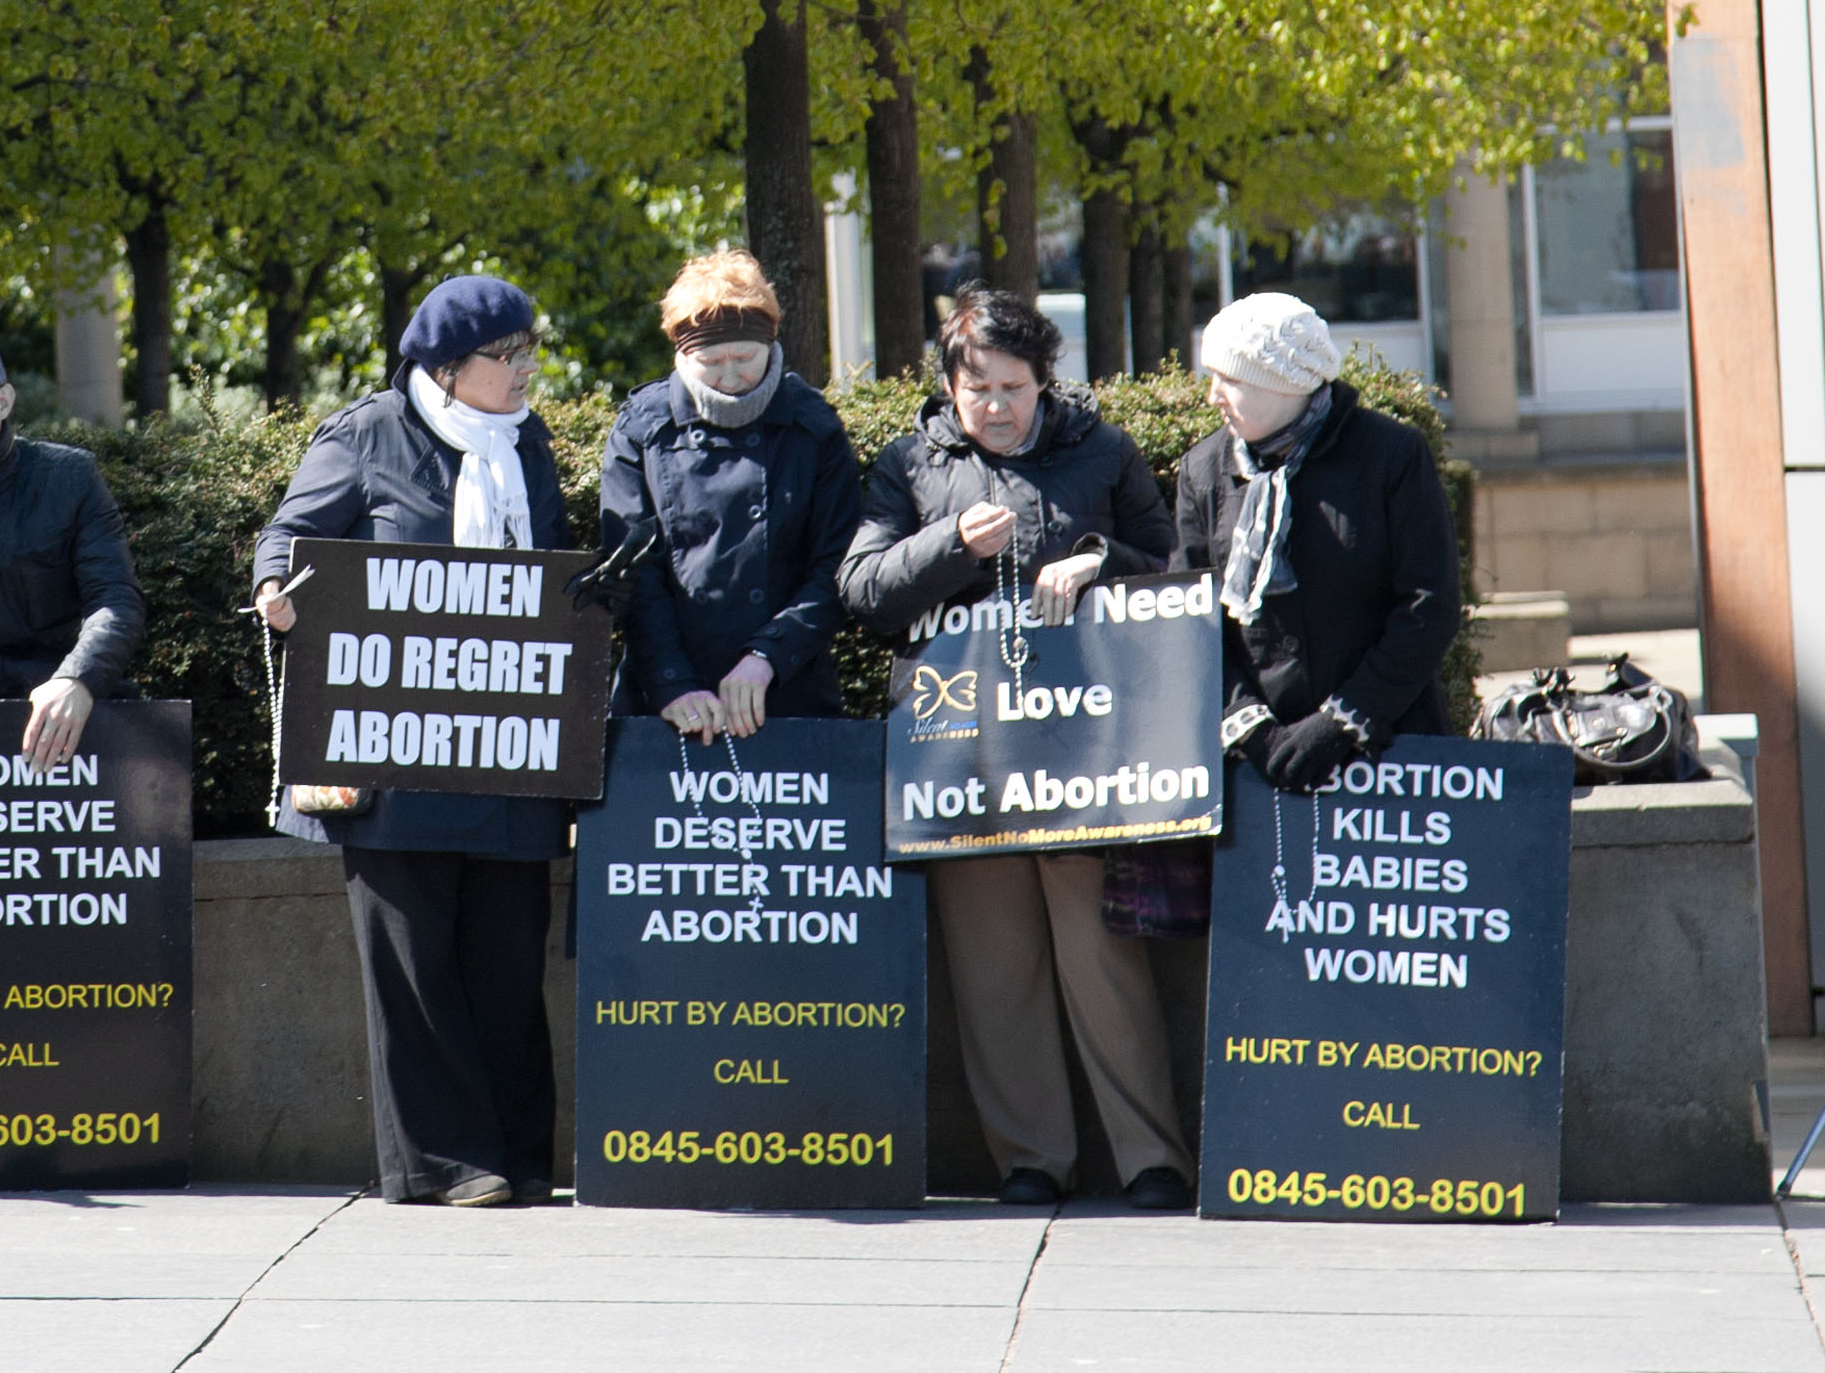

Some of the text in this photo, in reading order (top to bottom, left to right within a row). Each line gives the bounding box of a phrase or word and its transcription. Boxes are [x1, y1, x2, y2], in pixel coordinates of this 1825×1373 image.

[366, 557, 543, 617] WOMEN
[909, 574, 1213, 644] Wome Need
[327, 632, 573, 695] DO REGRET
[997, 682, 1113, 722] Love
[325, 710, 560, 771] ABORTION
[670, 771, 830, 805] WOMEN
[903, 761, 1210, 822] Not Abortion
[1304, 761, 1504, 801] BORTION
[655, 816, 847, 851] DESERVE
[1333, 807, 1452, 845] KILLS
[51, 847, 161, 878] THAN
[608, 863, 893, 898] BETTER THAN
[1313, 853, 1469, 894] BABIES
[641, 910, 858, 944] ABORTION
[1266, 900, 1512, 944] AND HURTS
[1304, 948, 1469, 988] WOMEN
[4, 983, 174, 1009] ABORTION?
[596, 1002, 906, 1028] HURT BY ABORTION?
[713, 1060, 789, 1084] CALL
[1224, 1037, 1543, 1078] HURT BY ABORTION?
[1342, 1100, 1421, 1130] CALL
[603, 1130, 894, 1167] 0845-603-8501
[1227, 1168, 1526, 1218] 0845-603-8501
